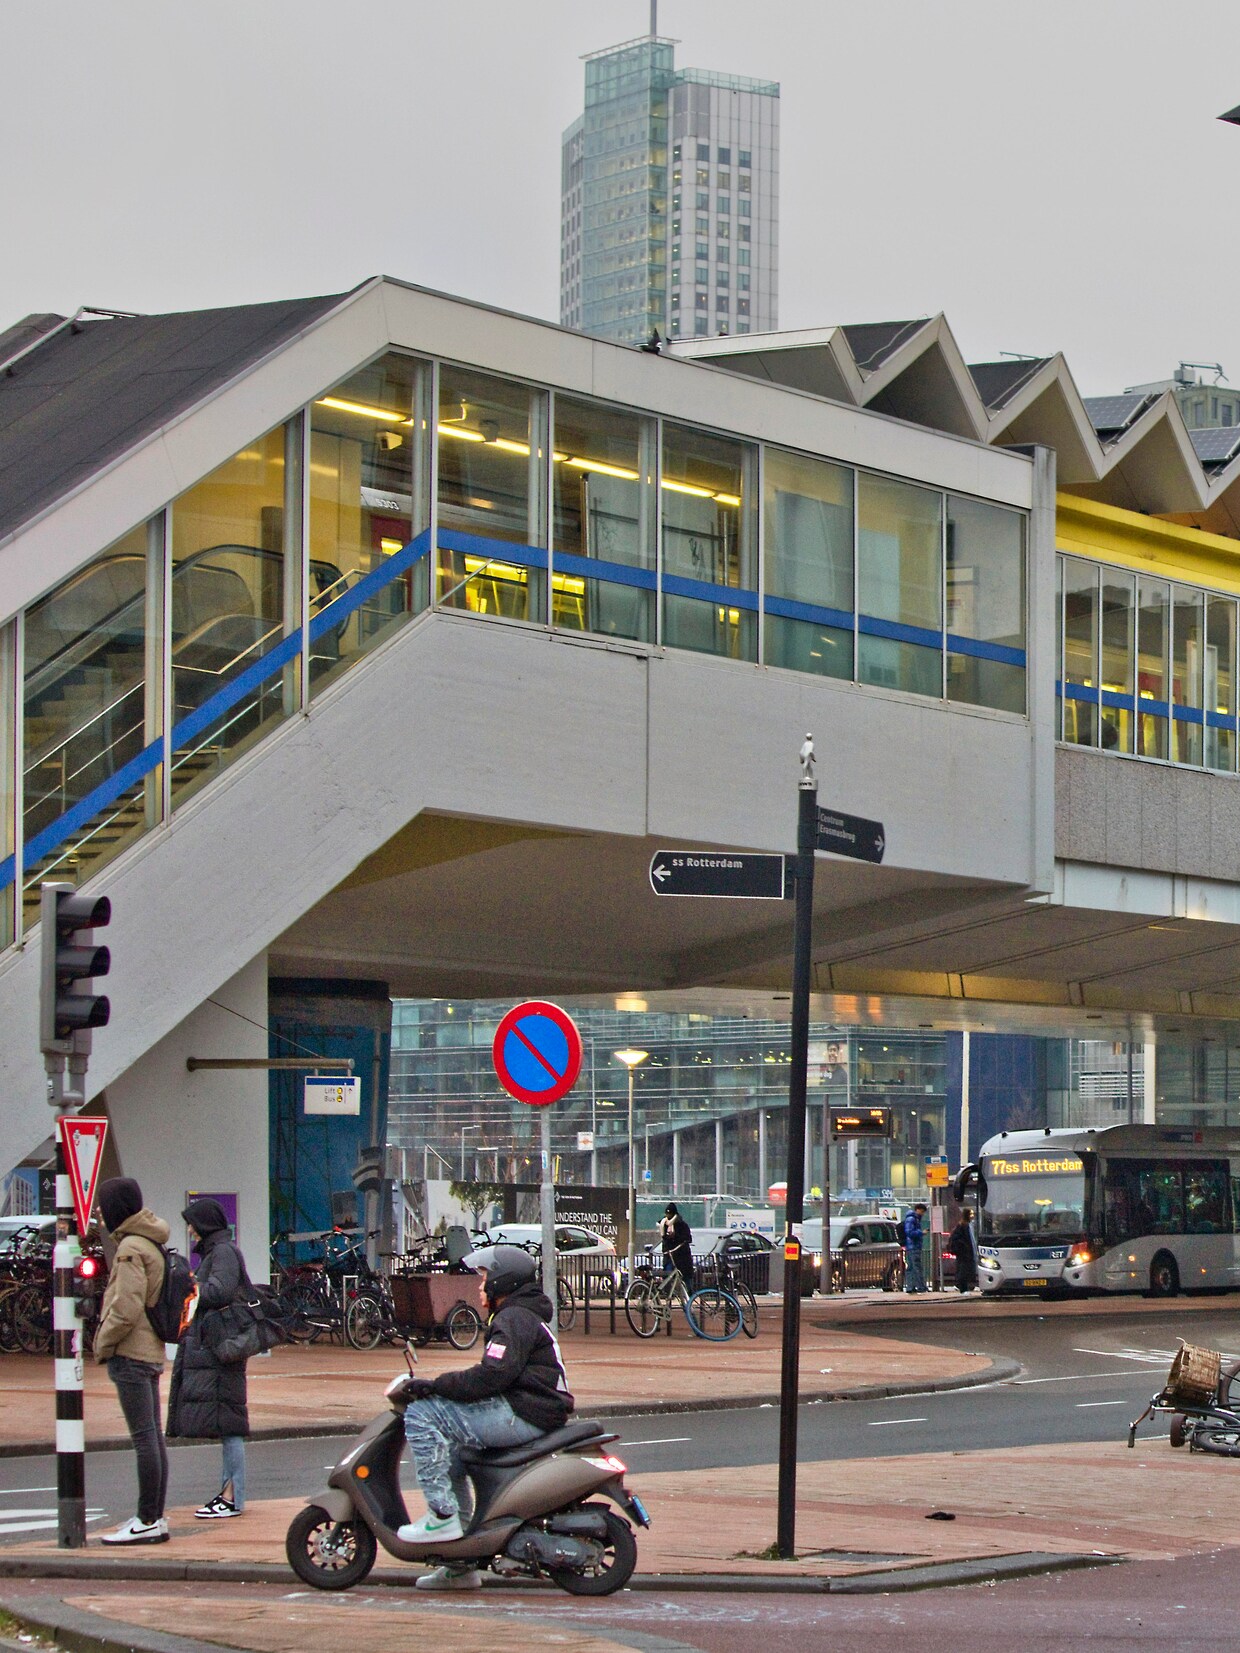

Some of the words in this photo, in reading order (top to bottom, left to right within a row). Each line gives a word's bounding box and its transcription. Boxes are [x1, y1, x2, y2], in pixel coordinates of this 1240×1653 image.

[820, 813, 844, 826] Centrum
[820, 824, 856, 843] Erasmusbrug
[672, 859, 684, 867] ss
[686, 857, 743, 869] Rotterdam
[554, 1212, 599, 1223] UNDERSTAND
[600, 1213, 612, 1224] THE
[603, 1225, 618, 1235] CAN
